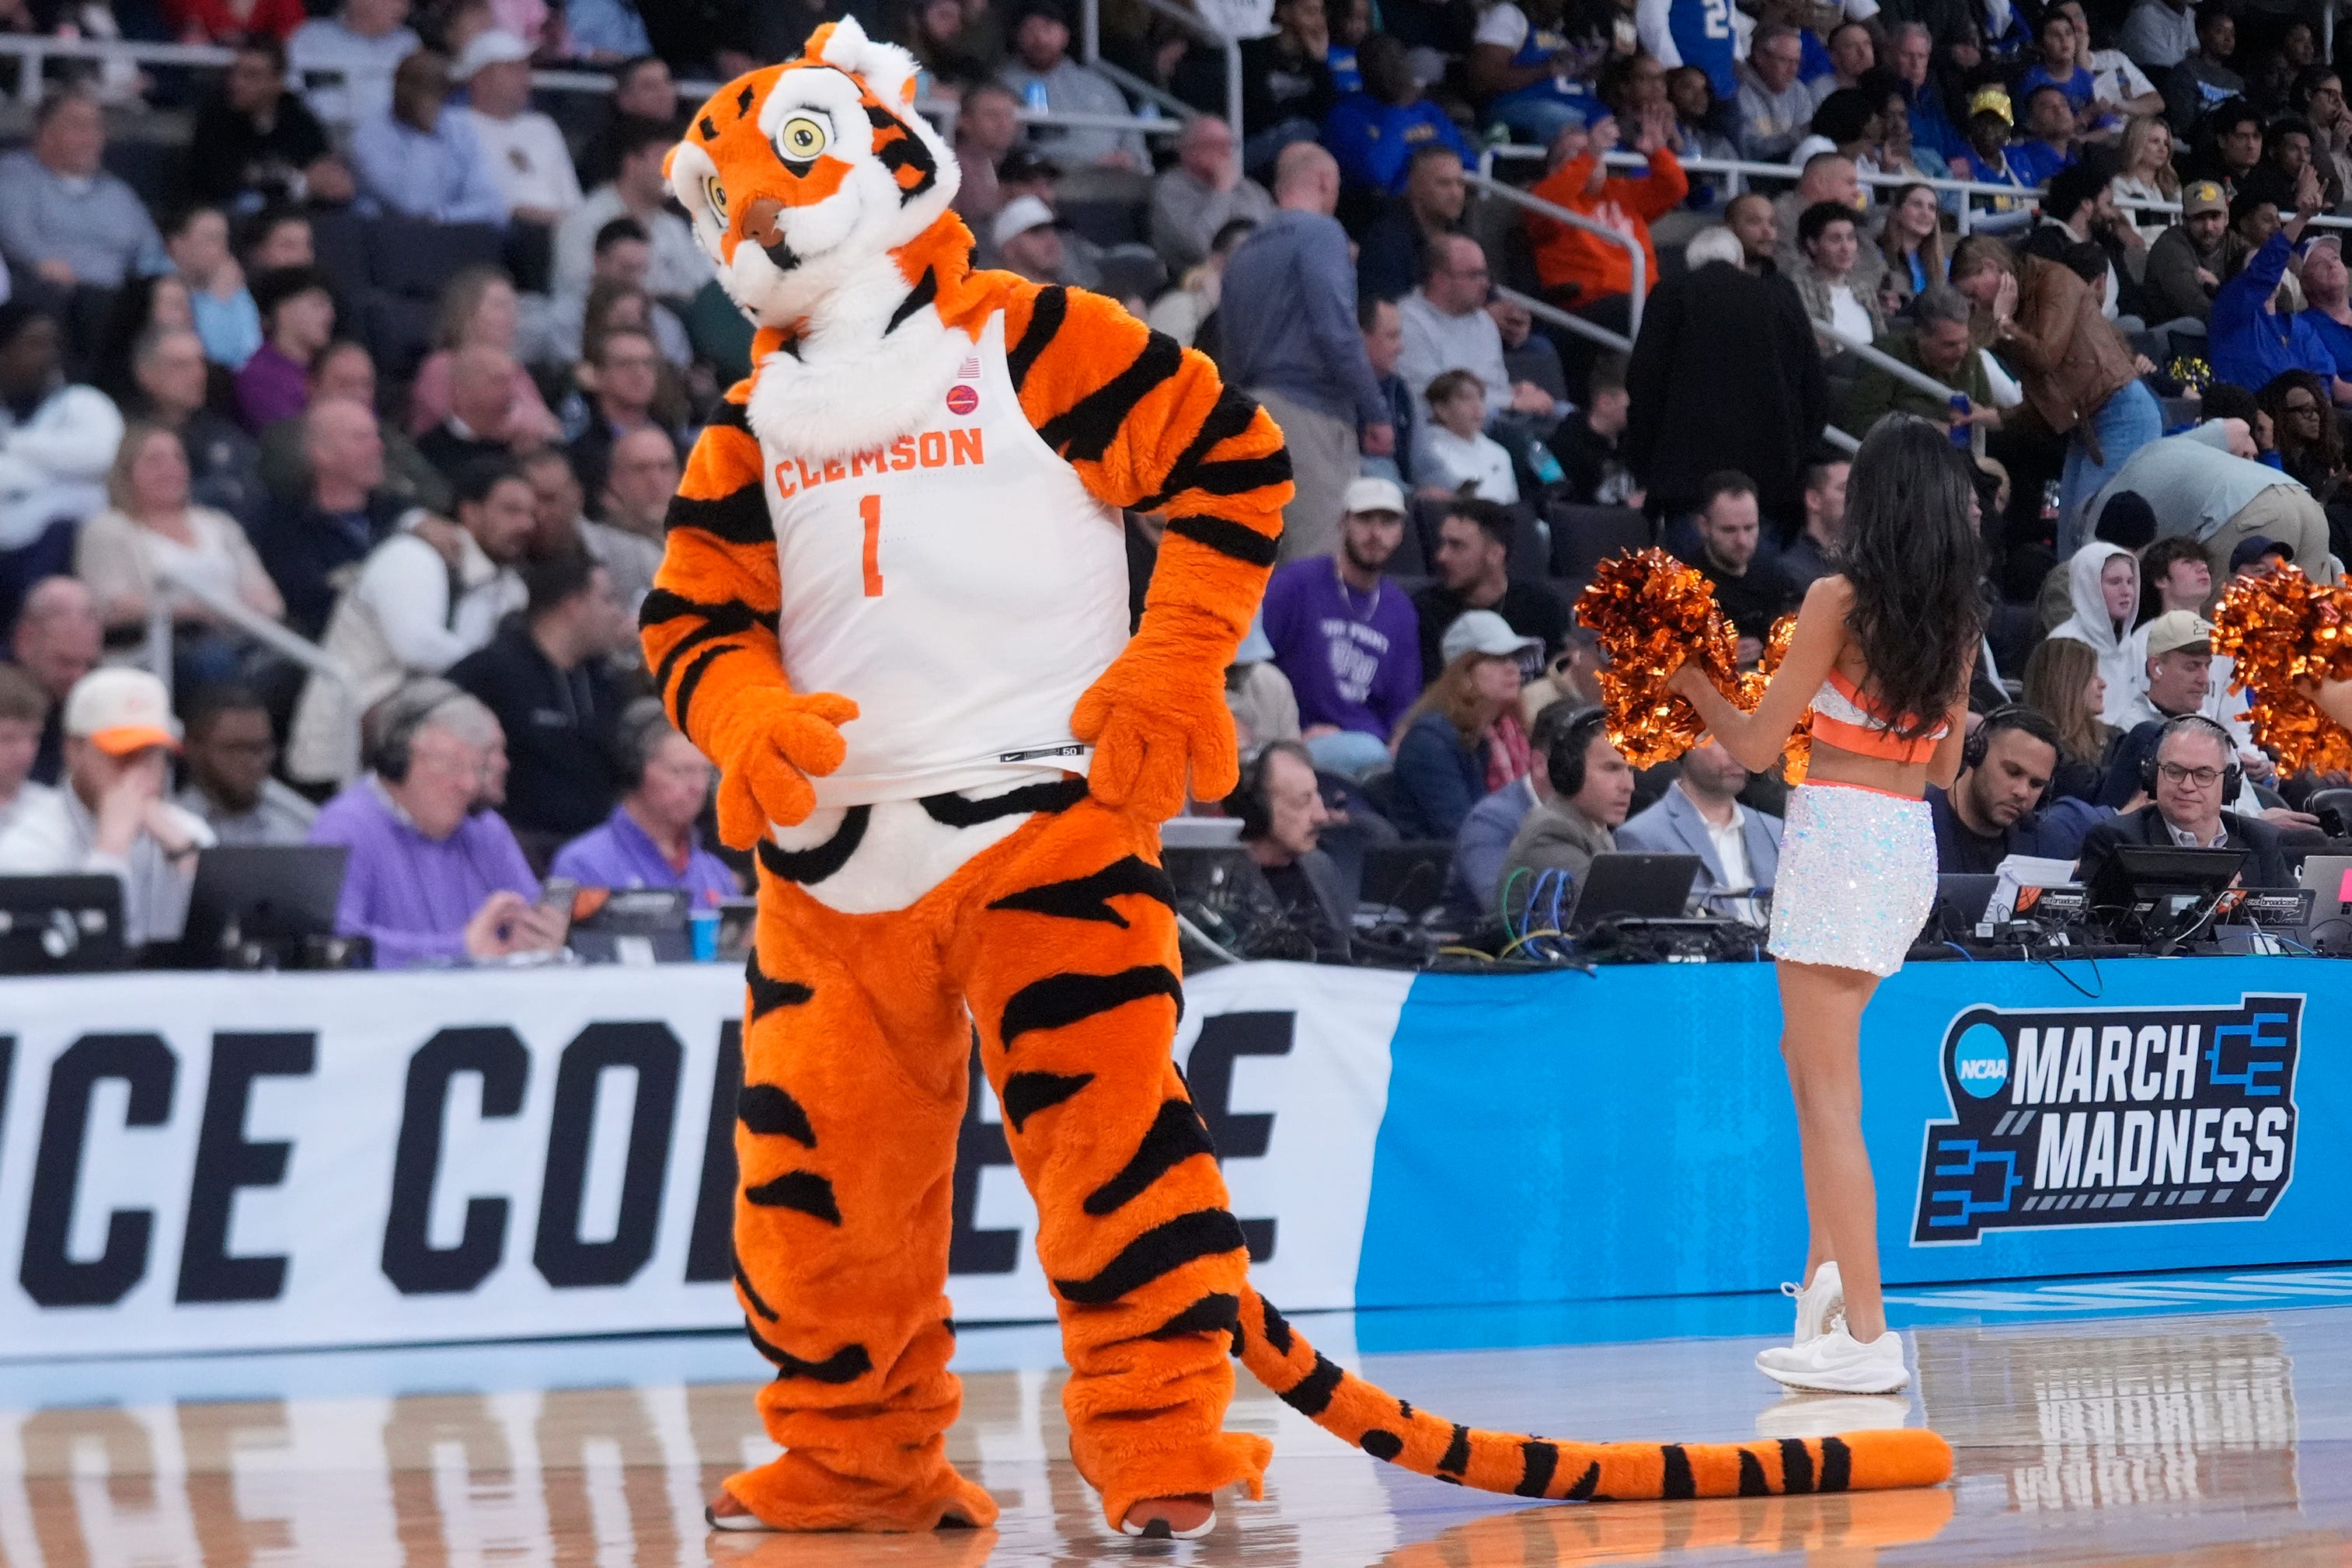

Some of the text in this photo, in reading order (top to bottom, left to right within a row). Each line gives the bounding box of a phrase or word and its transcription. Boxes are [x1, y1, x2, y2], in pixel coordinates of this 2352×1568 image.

[775, 428, 984, 499] CLEMSON
[859, 495, 883, 598] 1
[1063, 747, 1077, 756] 50
[1960, 1058, 2008, 1079] NCAA
[2012, 1025, 2200, 1104] MARCH
[0, 1030, 320, 1308] CE
[2033, 1107, 2288, 1190] MADNESS
